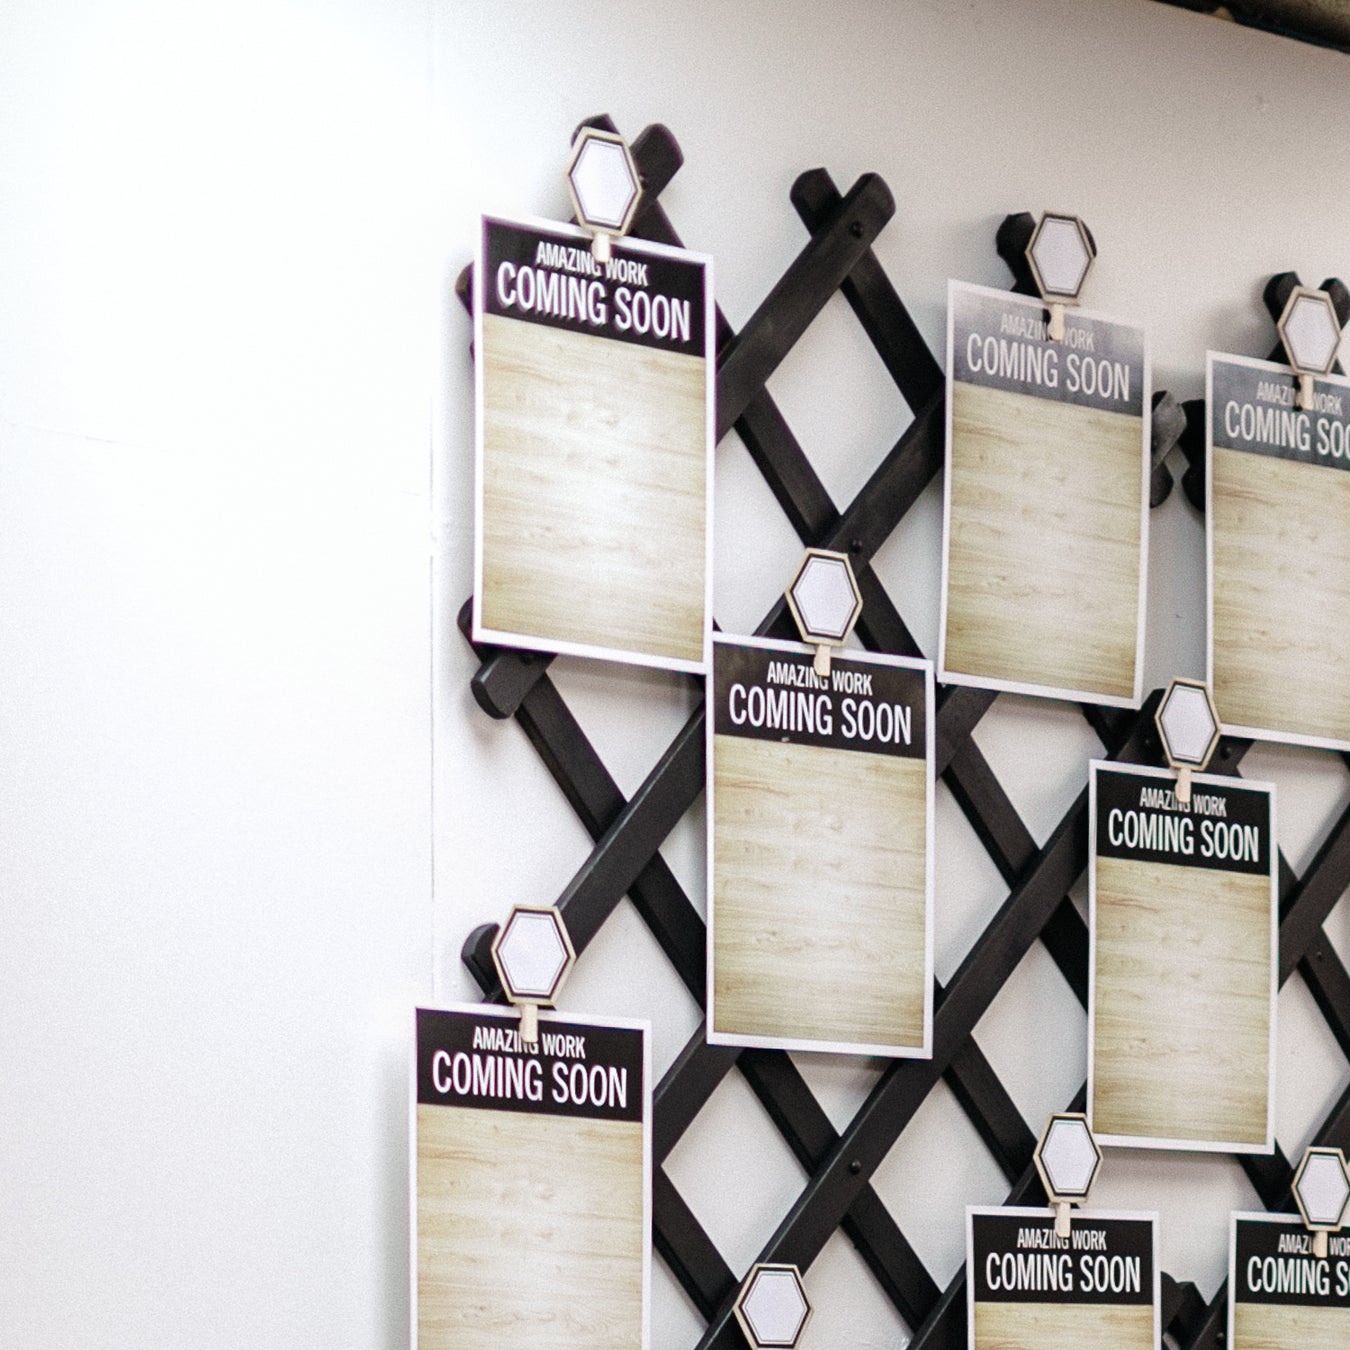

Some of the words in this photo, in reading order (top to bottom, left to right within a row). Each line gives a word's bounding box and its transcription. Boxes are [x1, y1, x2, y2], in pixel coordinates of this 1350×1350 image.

[603, 260, 648, 287] WORK
[497, 261, 607, 325] COMING
[615, 286, 691, 341] SOON
[967, 333, 1058, 388] COMING
[1066, 354, 1130, 401] SOON
[1225, 401, 1311, 451] COMING
[832, 669, 872, 695] WORK
[729, 683, 832, 735] COMING
[841, 698, 912, 744] SOON
[1192, 794, 1227, 817] WORK
[1108, 809, 1194, 855] COMING
[1200, 819, 1259, 862] SOON
[541, 1033, 586, 1059] WORK
[432, 1050, 543, 1100] COMING
[552, 1062, 627, 1107] SOON
[1072, 1230, 1107, 1251] WORK
[1278, 1233, 1313, 1257] AMAZI
[986, 1252, 1073, 1291] COMING
[1080, 1255, 1141, 1293] SOON
[1247, 1256, 1330, 1296] COMING
